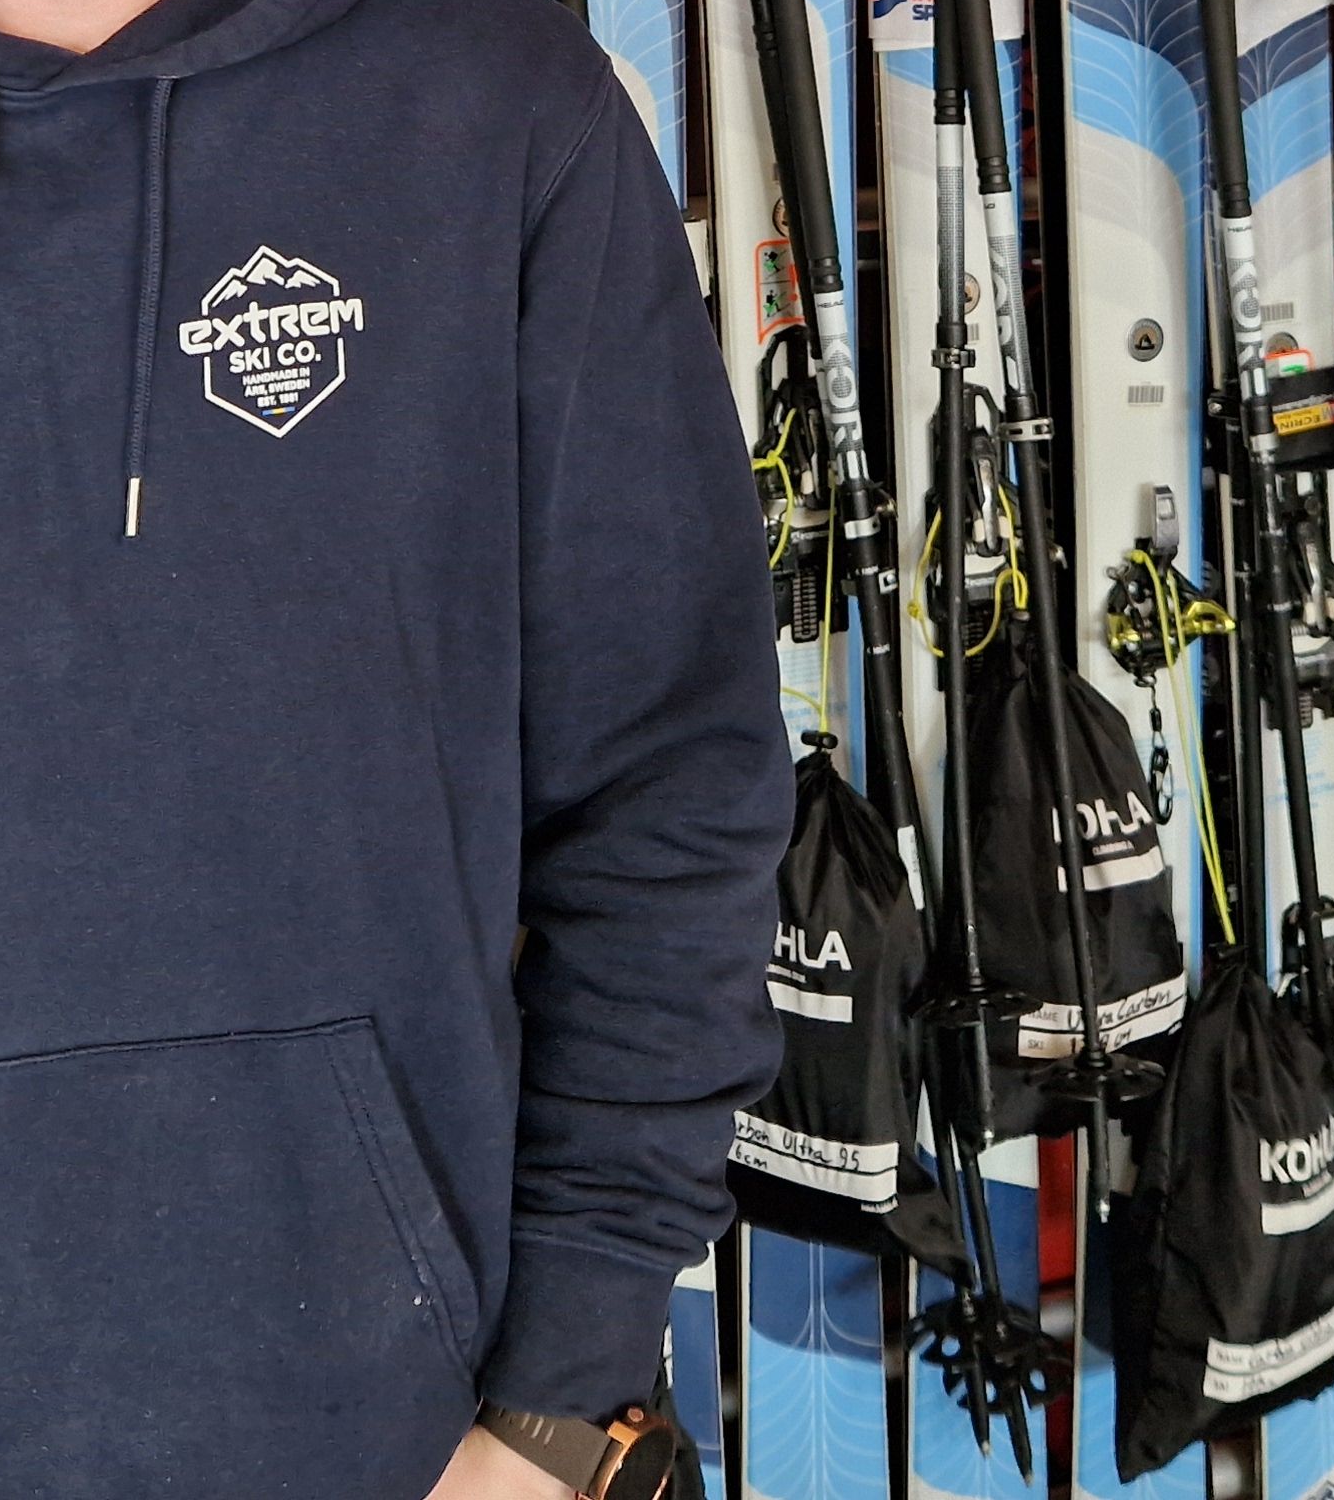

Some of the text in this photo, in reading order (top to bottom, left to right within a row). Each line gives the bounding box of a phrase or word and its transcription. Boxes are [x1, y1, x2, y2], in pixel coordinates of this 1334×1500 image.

[229, 340, 322, 374] SKI CO.
[242, 366, 310, 386] HANDMADE IN
[268, 378, 310, 394] SWEDEN
